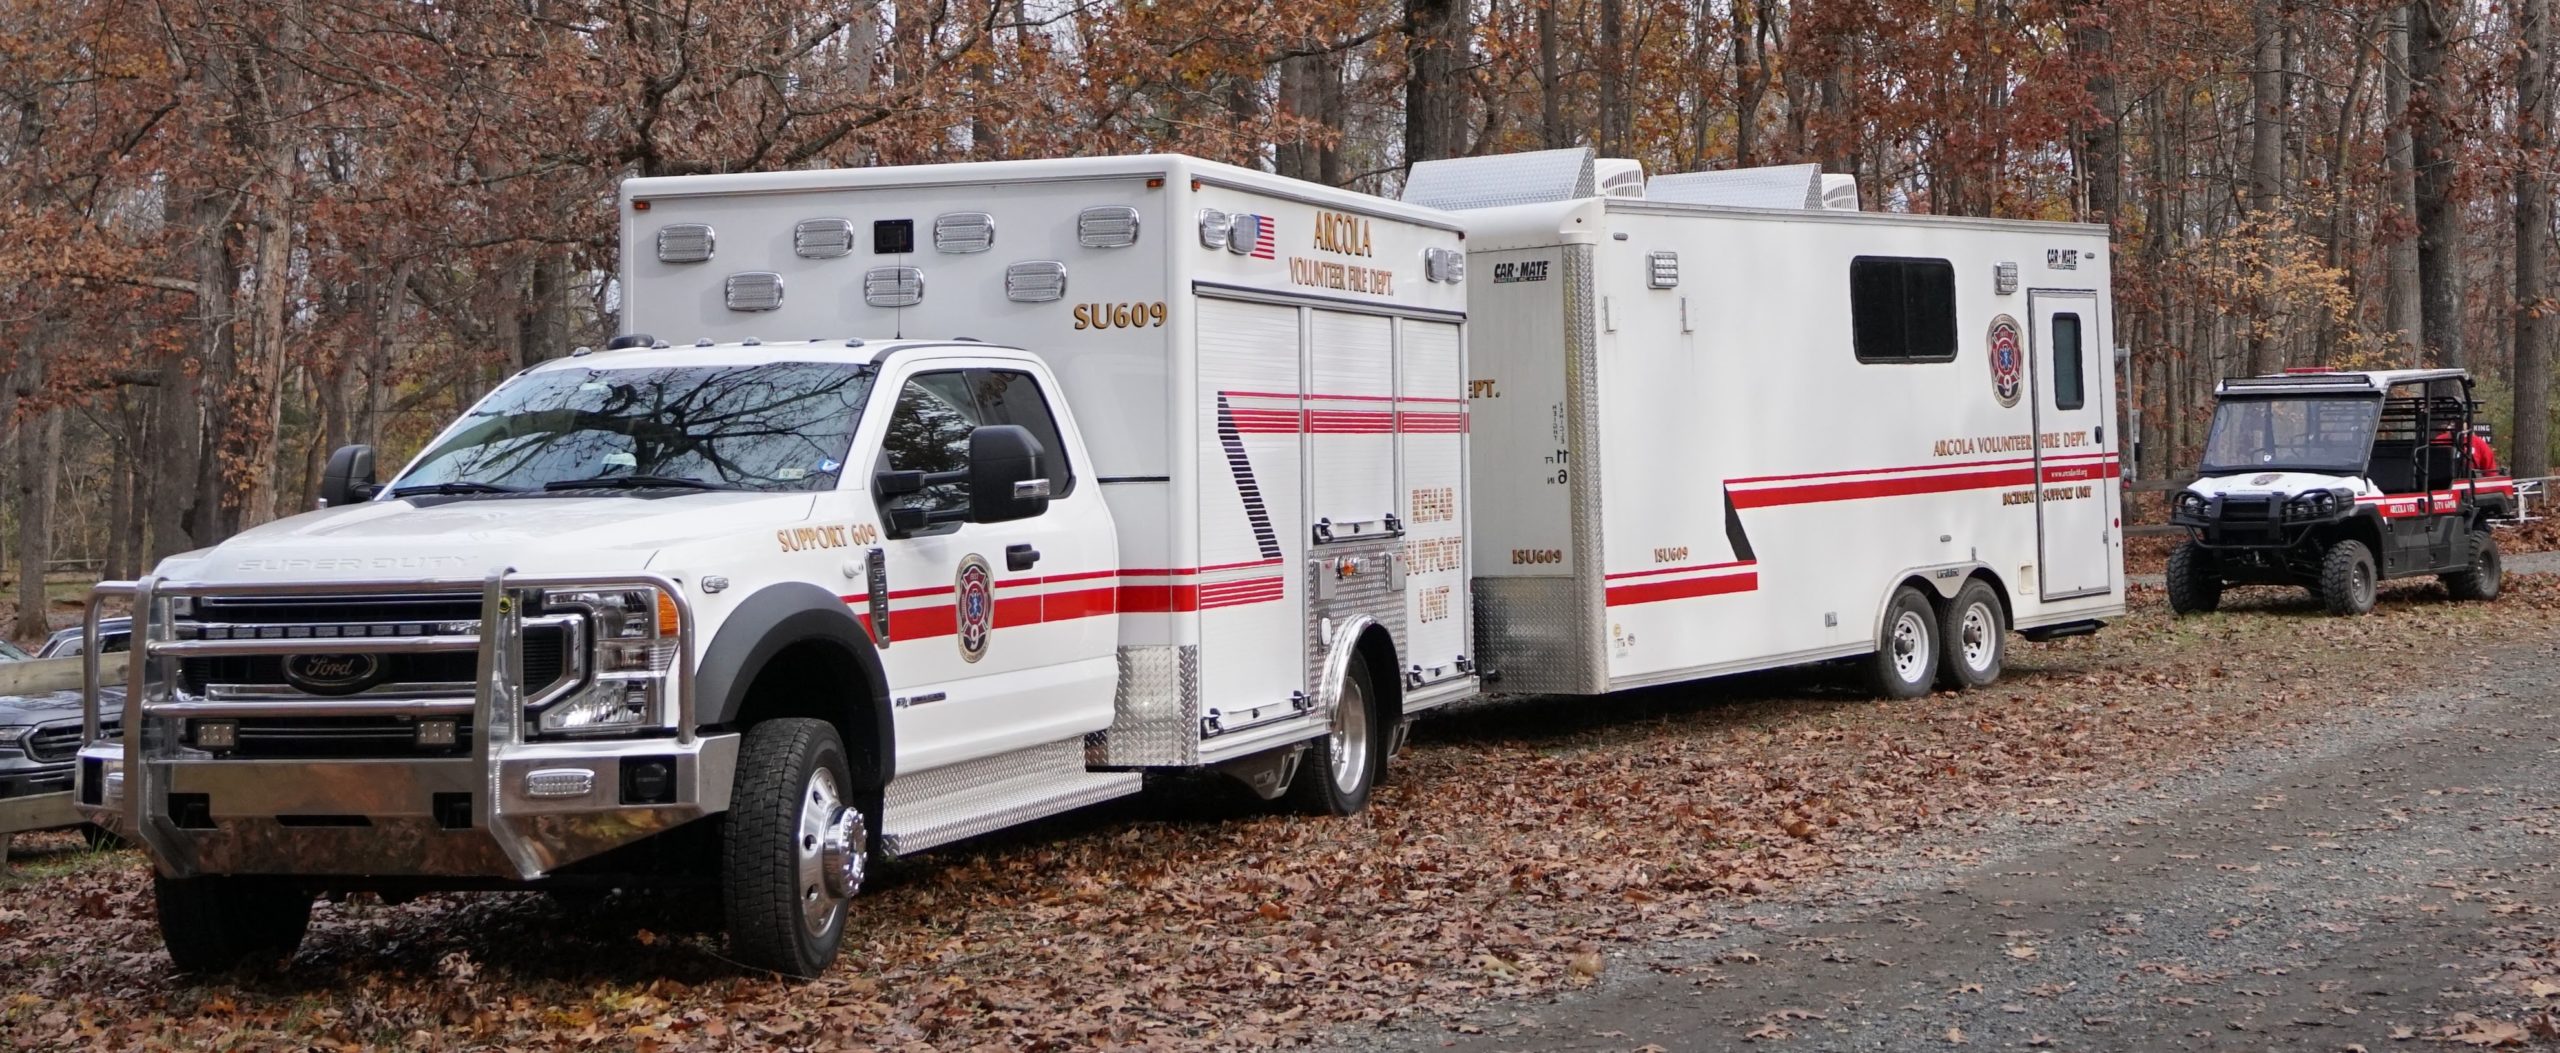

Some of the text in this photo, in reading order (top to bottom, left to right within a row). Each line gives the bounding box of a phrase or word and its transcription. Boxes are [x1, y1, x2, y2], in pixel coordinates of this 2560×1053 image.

[1314, 210, 1372, 258] ARCOLA
[1289, 256, 1394, 296] VOLUNTEER FIRE DEPT.
[1073, 301, 1168, 330] SU609
[2004, 374, 2012, 396] 9
[1933, 431, 2089, 456] ARCOLA VOLUNTEER FIRE DEPT.
[1412, 488, 1453, 523] REHAB
[2002, 486, 2092, 506] INCIDENT SUPPORT UNIT
[777, 524, 877, 552] SUPPORT 609
[237, 556, 468, 572] SUPER DUTY
[1405, 536, 1462, 576] SUPPORT
[1512, 549, 1562, 565] ISU609
[1654, 546, 1689, 563] ISU609
[1419, 585, 1450, 624] UNIT
[970, 624, 979, 649] 9
[305, 656, 354, 676] Ford
